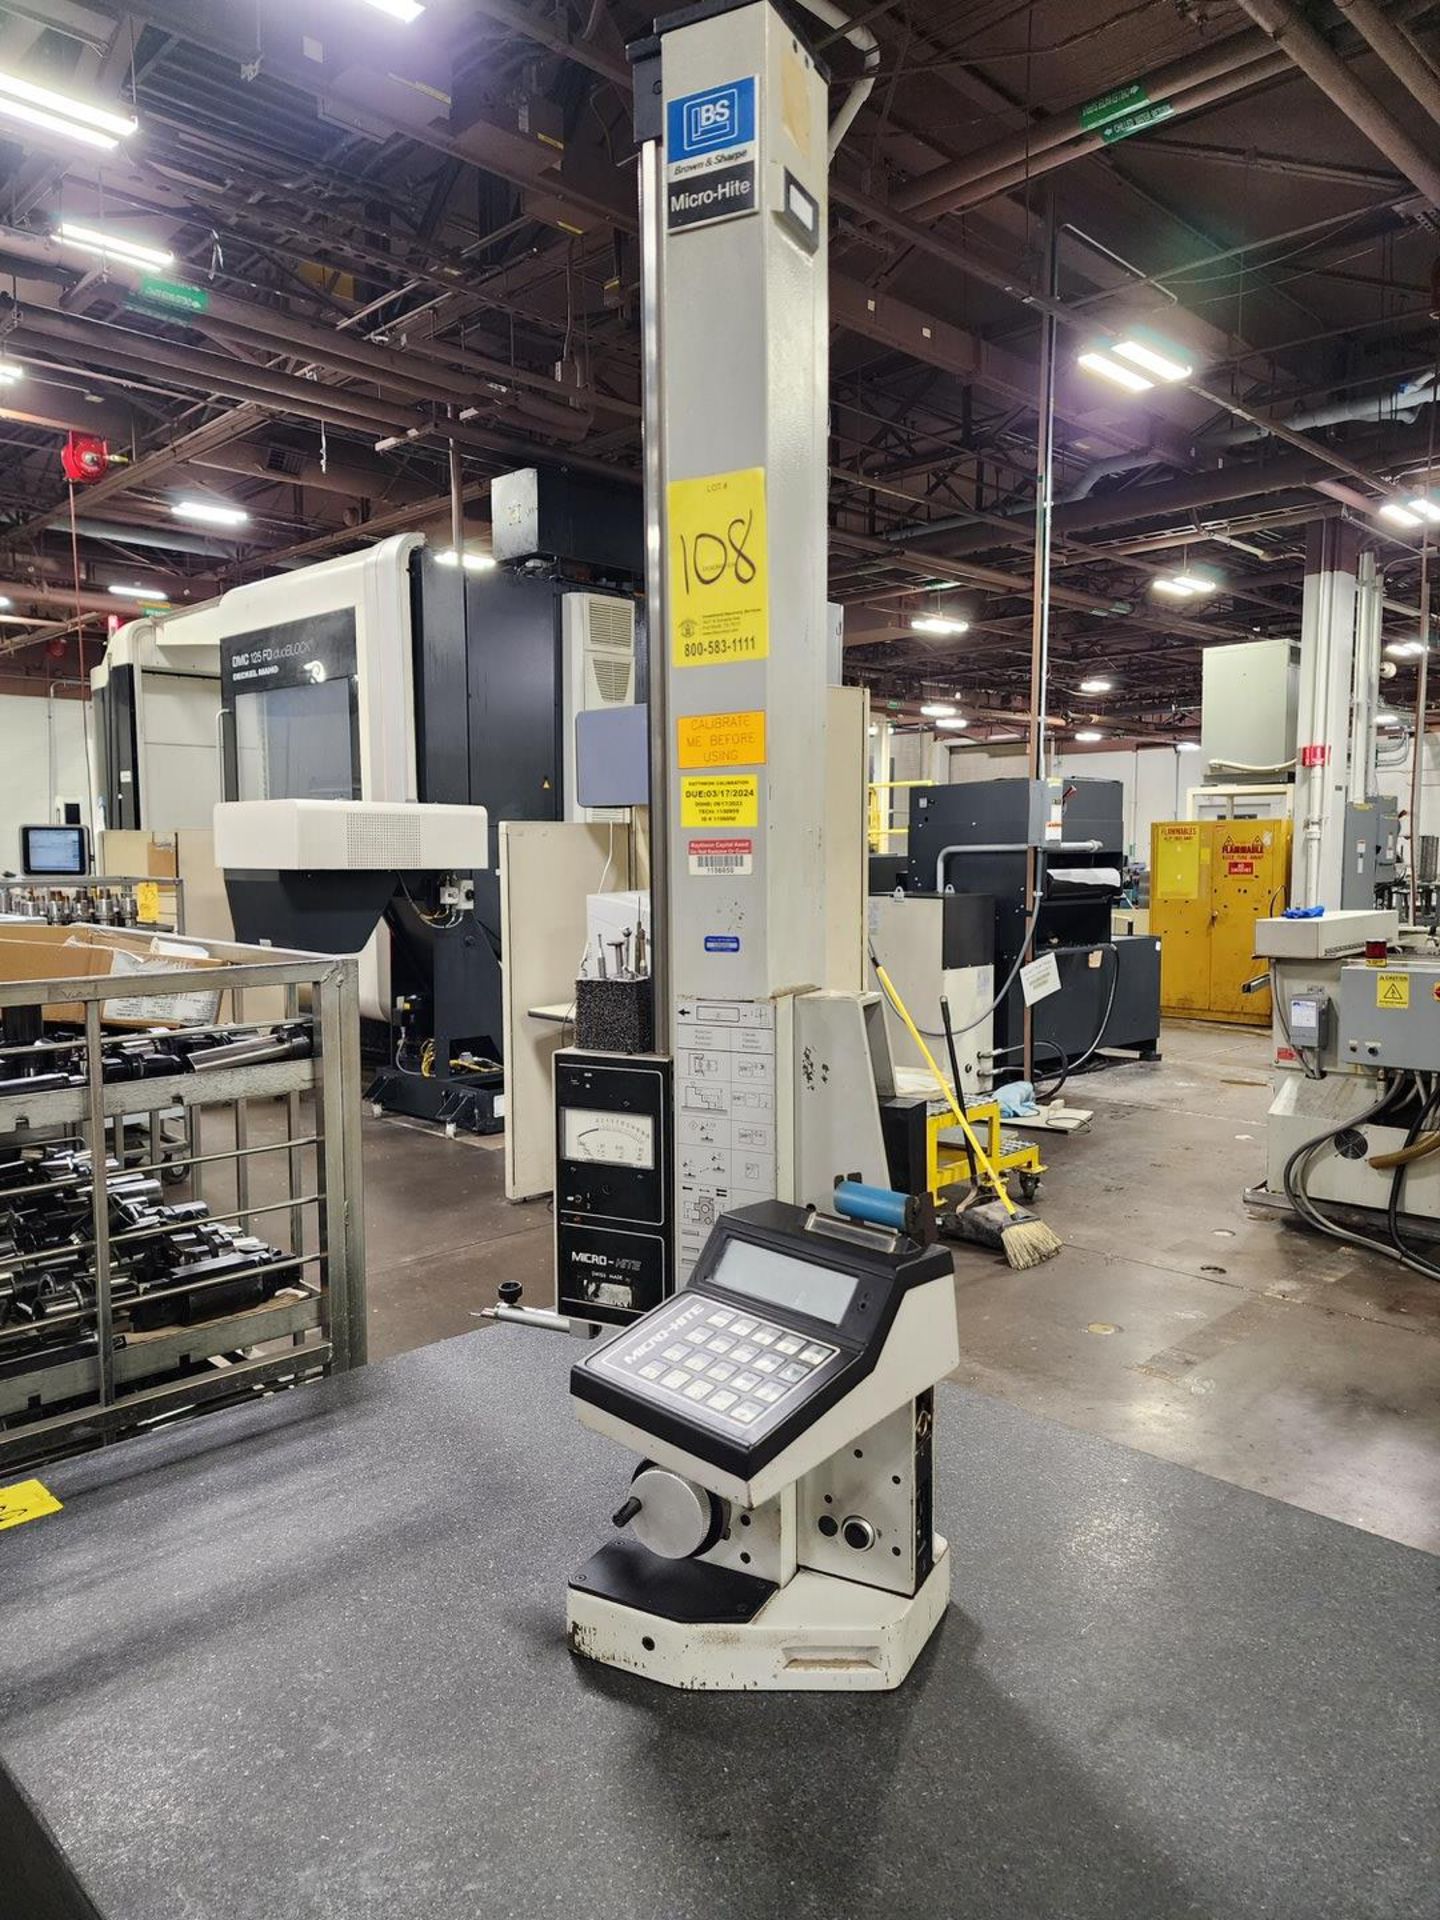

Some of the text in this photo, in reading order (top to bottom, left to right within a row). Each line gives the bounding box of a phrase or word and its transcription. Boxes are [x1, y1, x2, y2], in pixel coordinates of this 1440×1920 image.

[674, 149, 748, 176] Brown & Sharpe
[670, 178, 751, 212] Micro-Hite
[707, 483, 722, 493] LOT
[680, 508, 756, 595] 108
[684, 635, 756, 657] 800-583-1111
[231, 653, 250, 668] DMC
[690, 714, 751, 731] CALIBRATE
[686, 731, 756, 747] ME BEFORE
[703, 749, 739, 763] USING
